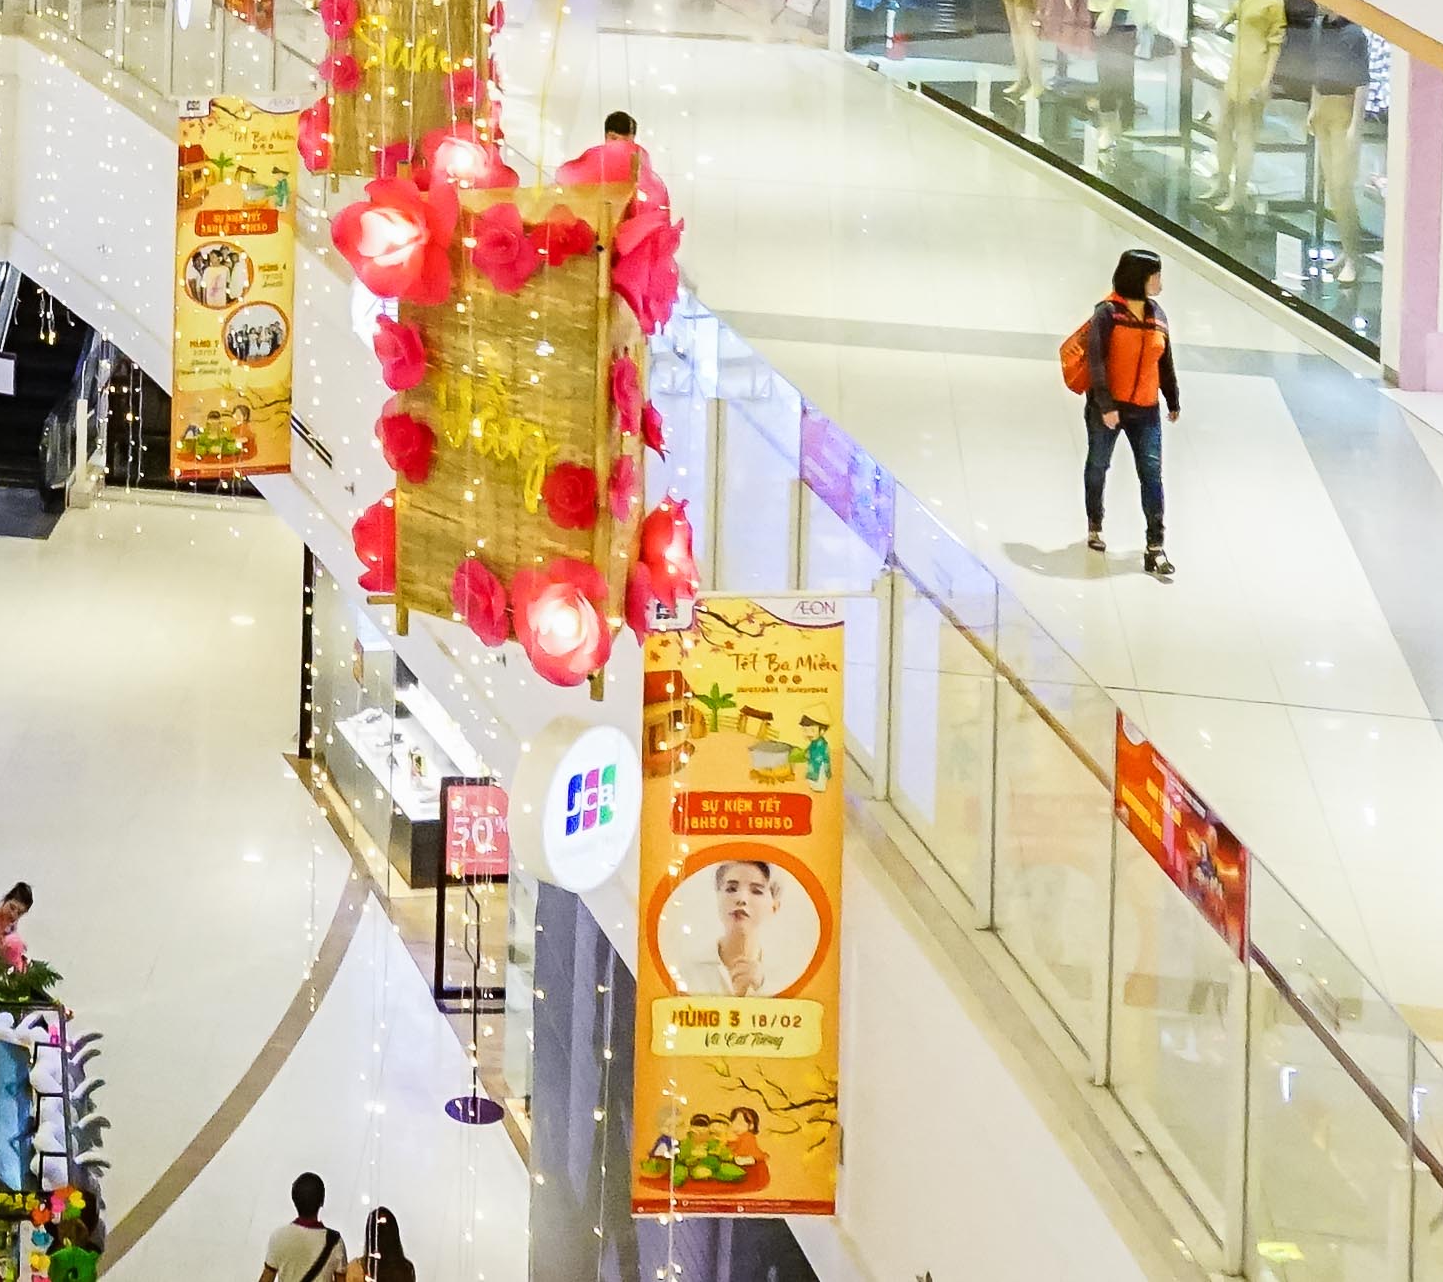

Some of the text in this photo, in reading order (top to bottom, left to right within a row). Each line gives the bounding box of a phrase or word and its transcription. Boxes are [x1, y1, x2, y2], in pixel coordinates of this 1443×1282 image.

[766, 653, 791, 673] Ba
[565, 763, 617, 837] JCB
[759, 797, 782, 813] TẾT
[729, 1010, 741, 1027] 3
[751, 1014, 803, 1030] 18/02
